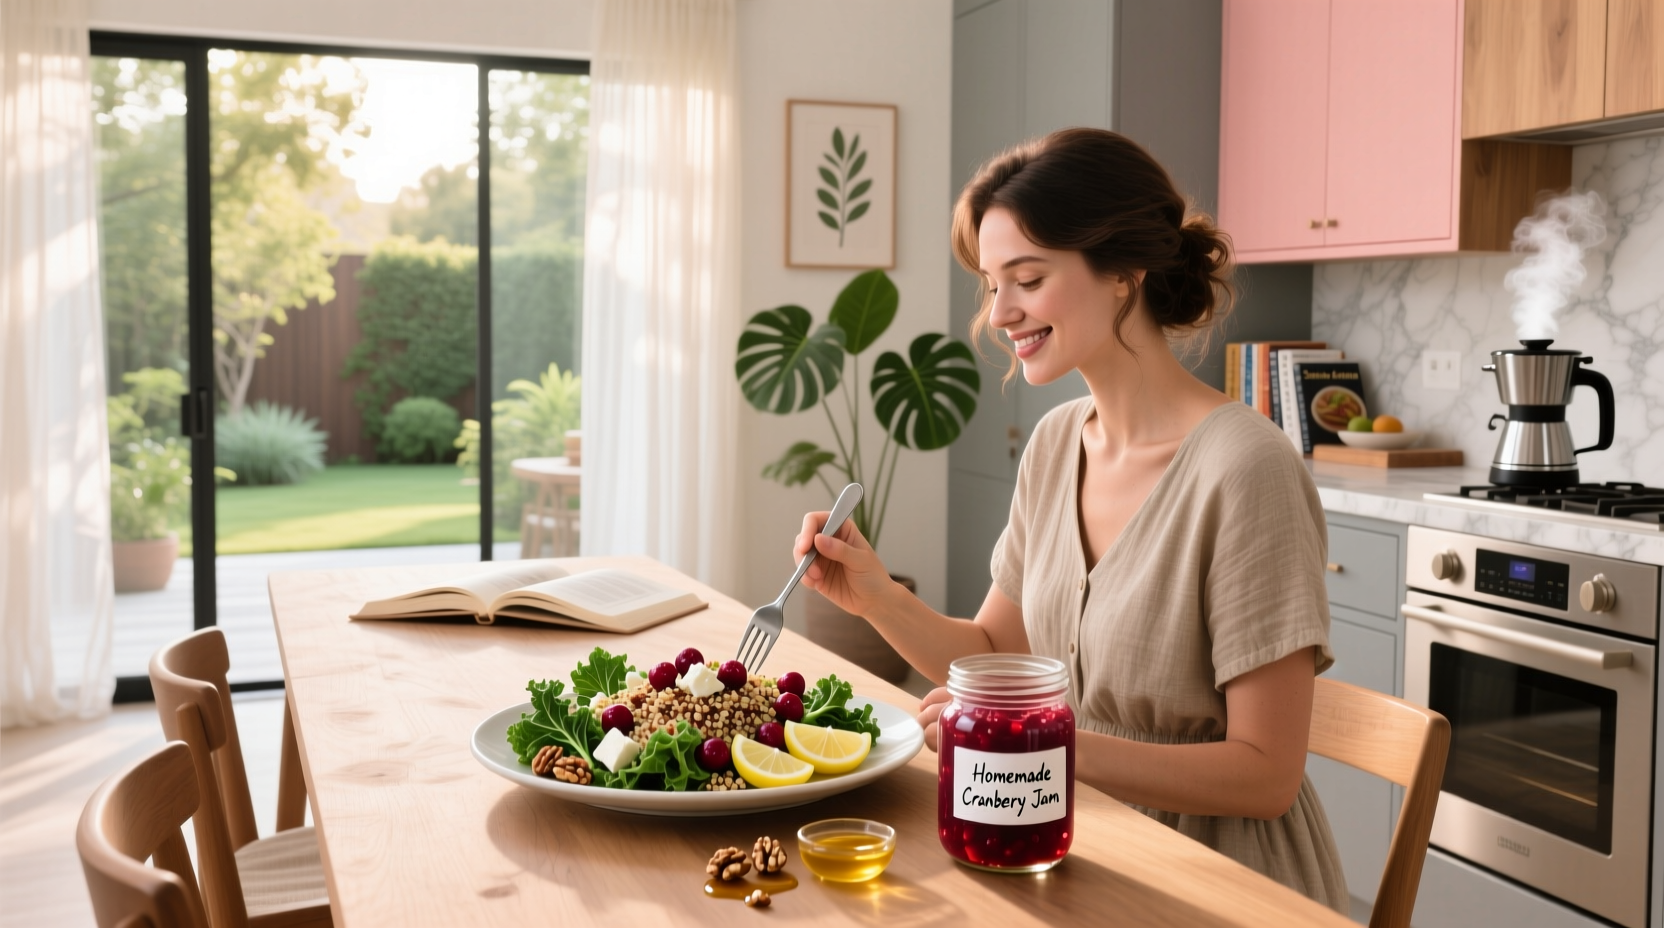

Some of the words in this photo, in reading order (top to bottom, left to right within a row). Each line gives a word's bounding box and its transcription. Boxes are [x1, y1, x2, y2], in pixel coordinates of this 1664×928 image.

[973, 762, 1051, 783] Homemade
[962, 786, 1026, 818] Cranbery
[1031, 788, 1060, 809] Jam
